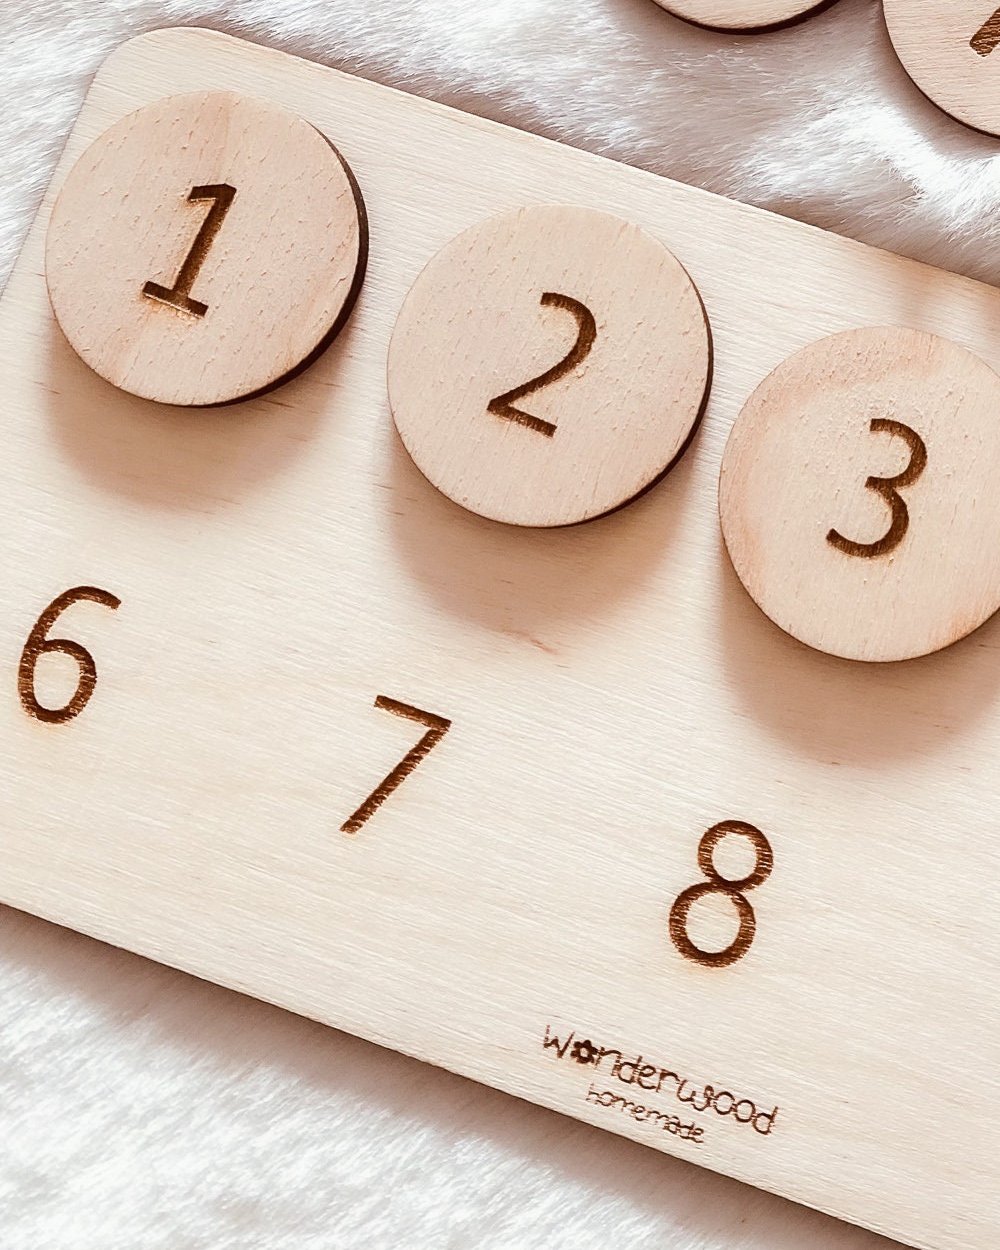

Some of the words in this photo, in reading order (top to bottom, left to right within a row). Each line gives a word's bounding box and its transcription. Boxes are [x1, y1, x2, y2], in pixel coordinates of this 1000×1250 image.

[142, 183, 237, 317] 1
[488, 293, 597, 436] 2
[827, 419, 927, 559] 3
[18, 586, 121, 724] 6
[341, 696, 452, 834] 7
[670, 821, 773, 967] 8
[585, 1083, 705, 1144] homemade
